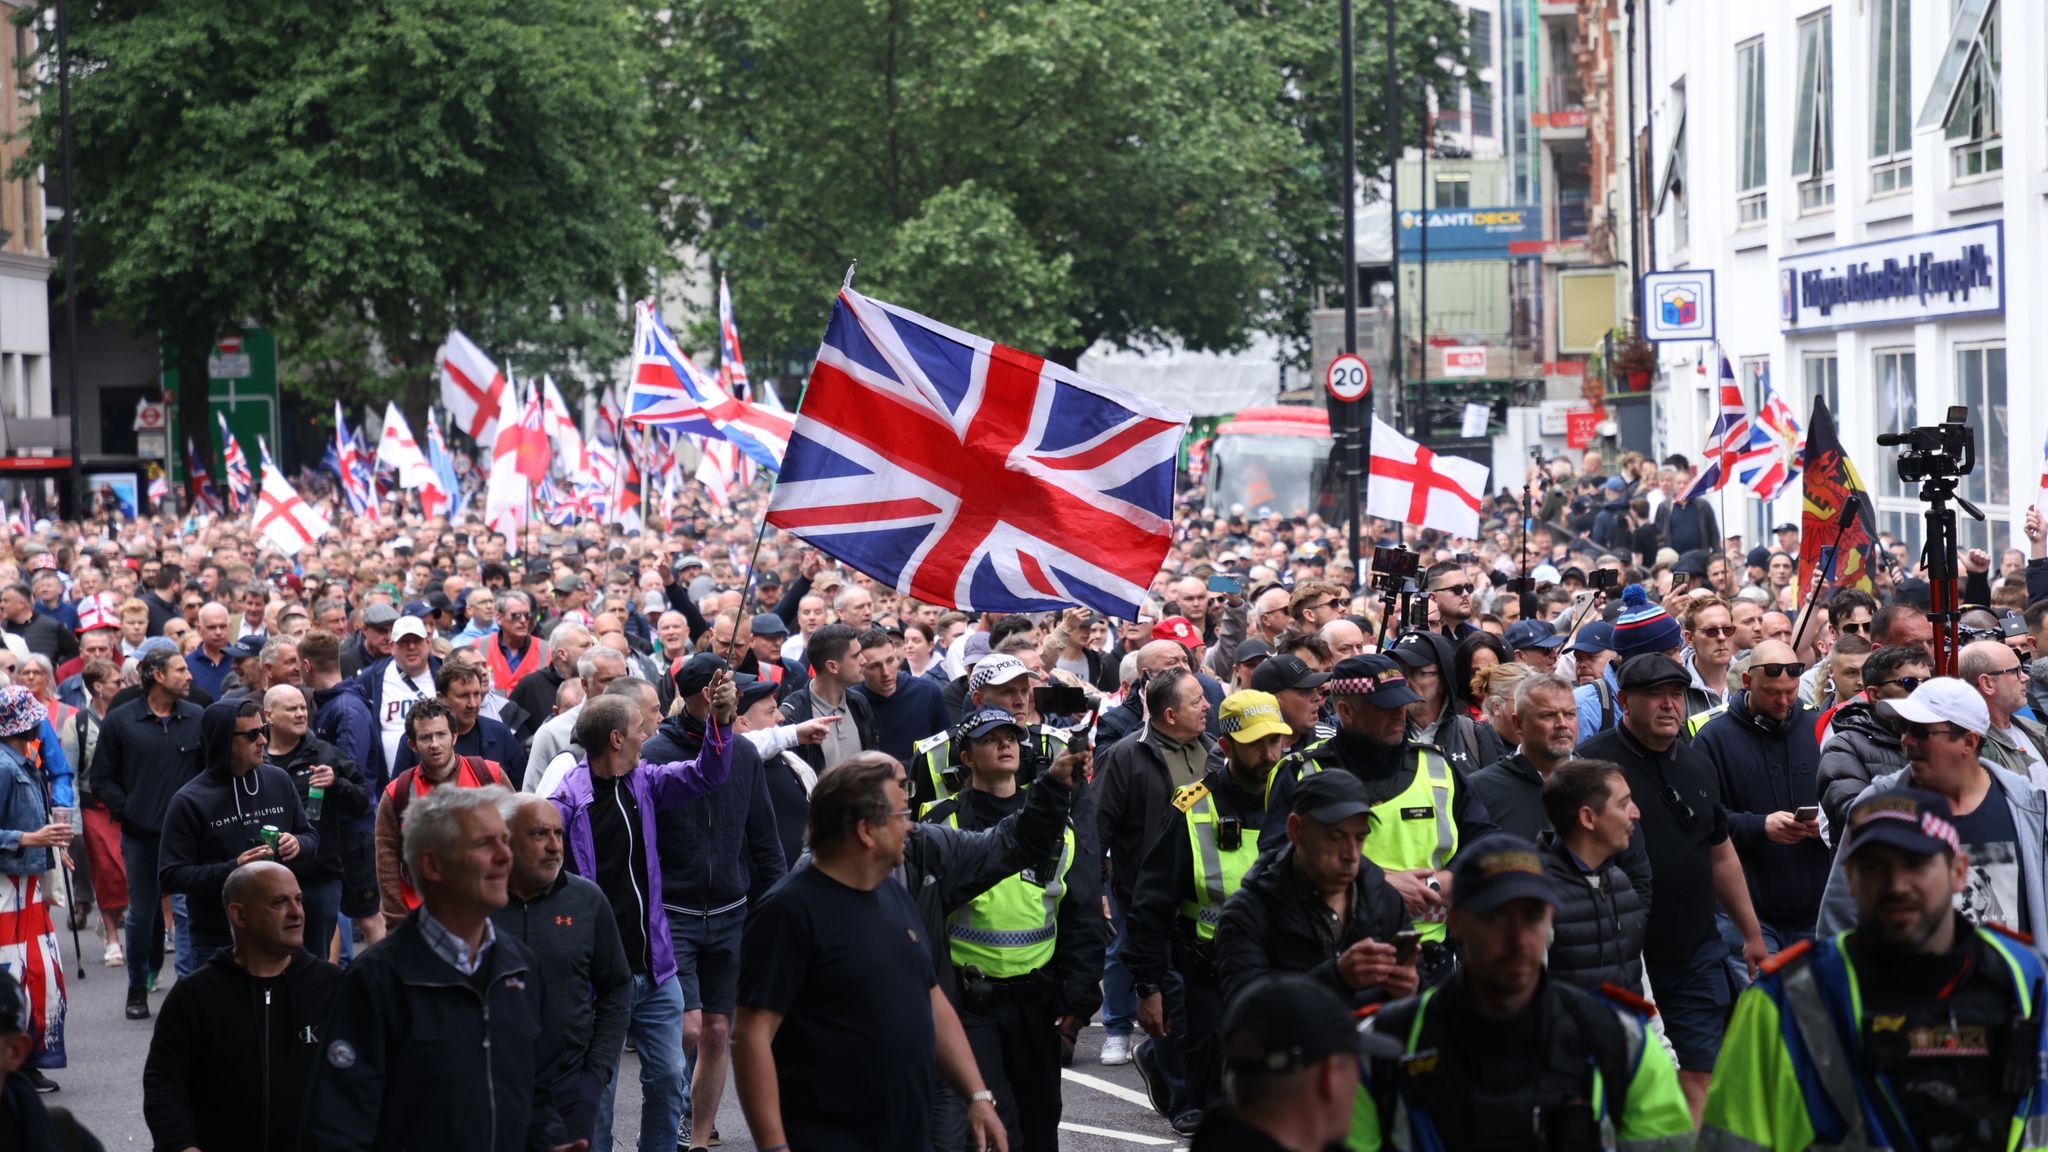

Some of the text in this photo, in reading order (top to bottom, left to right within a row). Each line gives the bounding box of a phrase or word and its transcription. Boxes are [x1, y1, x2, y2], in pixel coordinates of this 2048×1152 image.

[1334, 367, 1364, 386] 20
[996, 659, 1023, 671] POLIC
[1244, 704, 1274, 719] POLICE
[254, 806, 285, 817] HILFIGER
